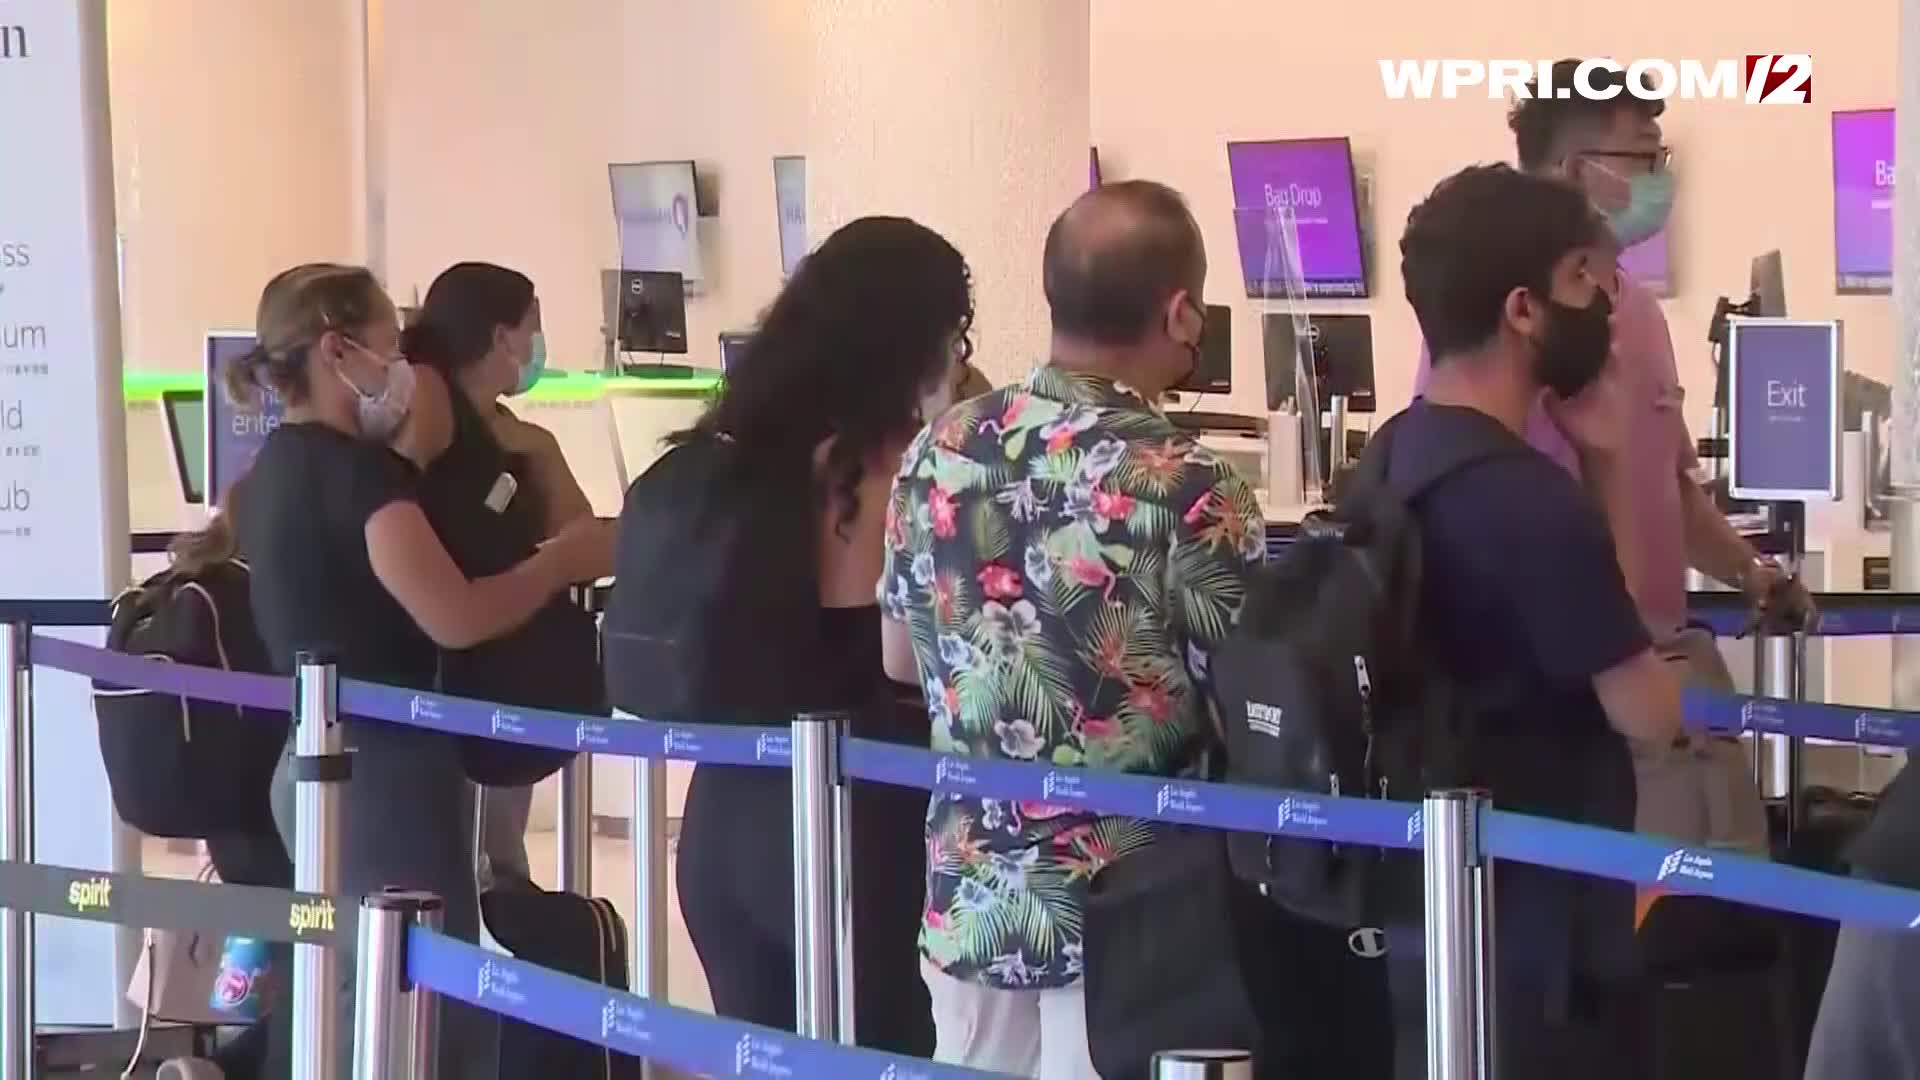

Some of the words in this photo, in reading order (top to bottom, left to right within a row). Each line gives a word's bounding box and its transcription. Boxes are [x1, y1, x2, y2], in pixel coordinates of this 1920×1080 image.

[1767, 378, 1808, 408] Exit
[68, 878, 113, 912] spirit
[288, 898, 336, 937] spirit
